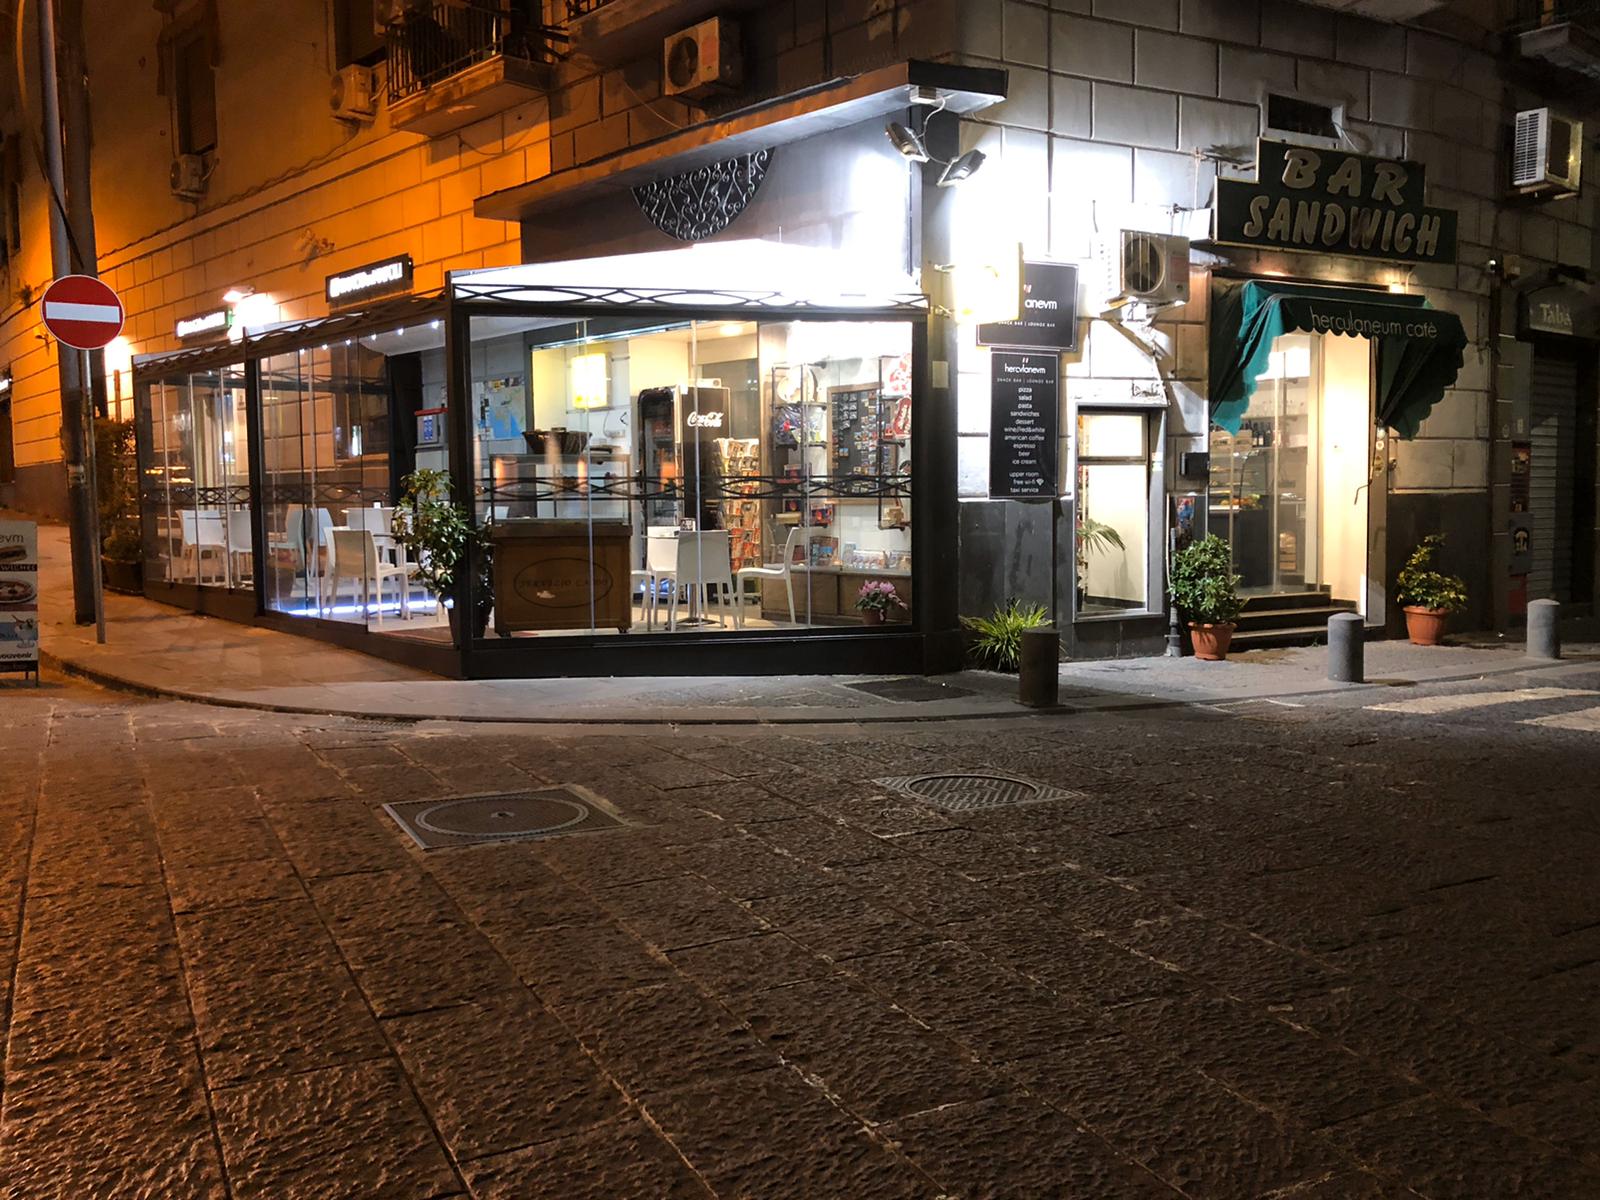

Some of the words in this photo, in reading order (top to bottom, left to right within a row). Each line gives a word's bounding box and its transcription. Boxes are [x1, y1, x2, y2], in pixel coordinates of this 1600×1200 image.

[1282, 149, 1408, 205] BAR
[1243, 195, 1441, 256] SANDWICH
[1309, 305, 1401, 334] herculaneum
